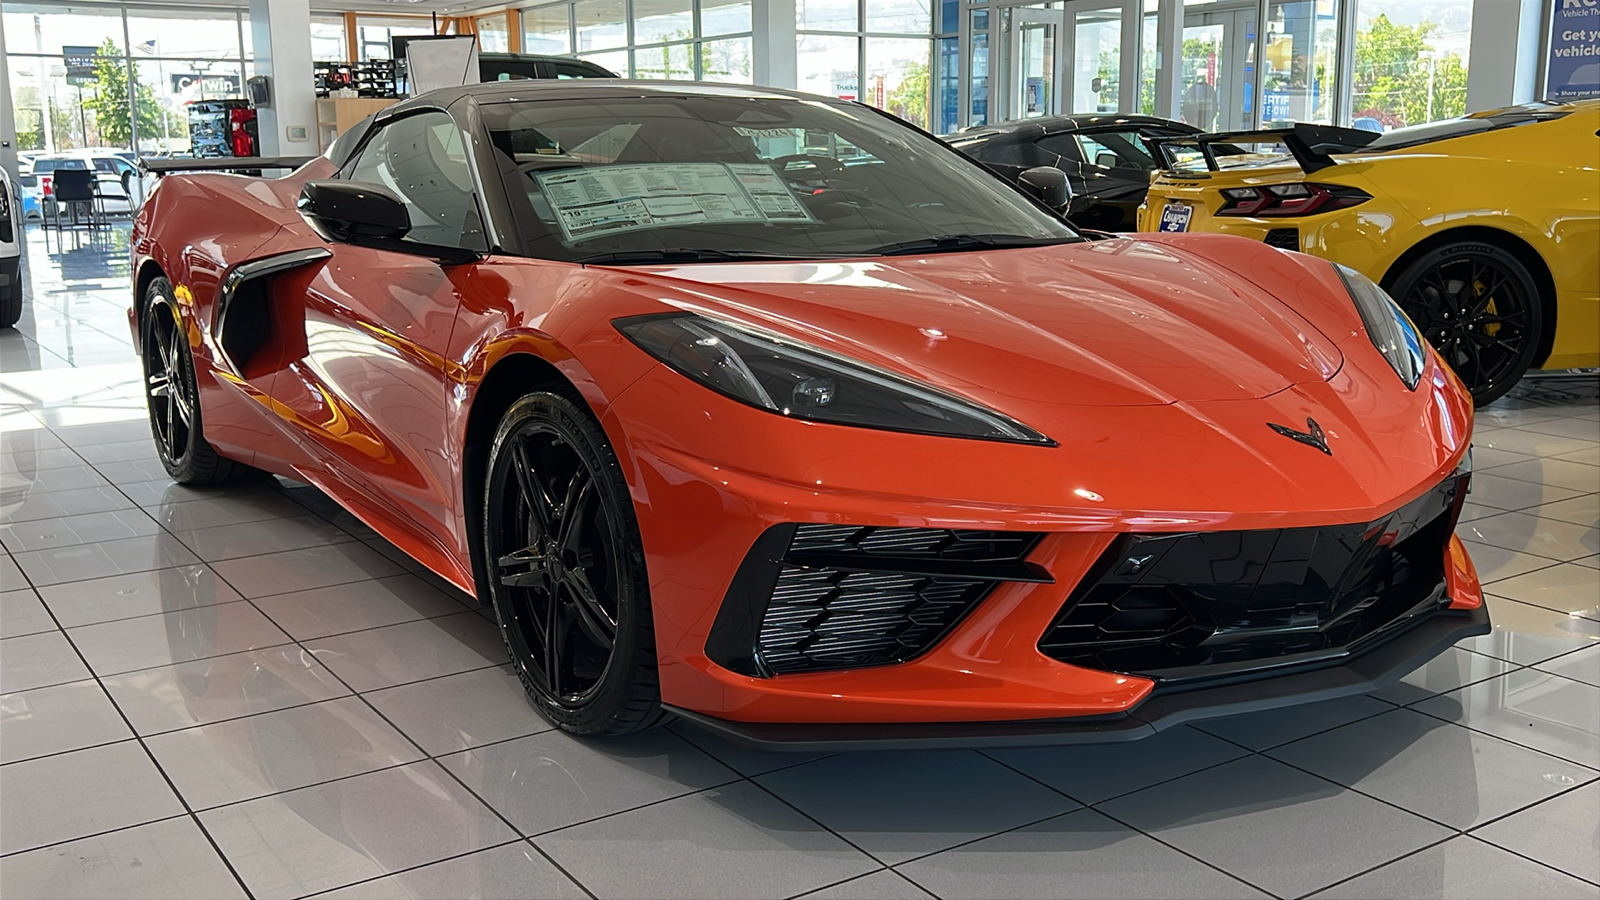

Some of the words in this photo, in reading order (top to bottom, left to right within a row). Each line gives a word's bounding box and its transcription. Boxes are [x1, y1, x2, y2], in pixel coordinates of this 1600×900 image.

[1562, 9, 1589, 17] Vehicle
[1562, 30, 1586, 41] Get
[178, 77, 233, 92] Crwin
